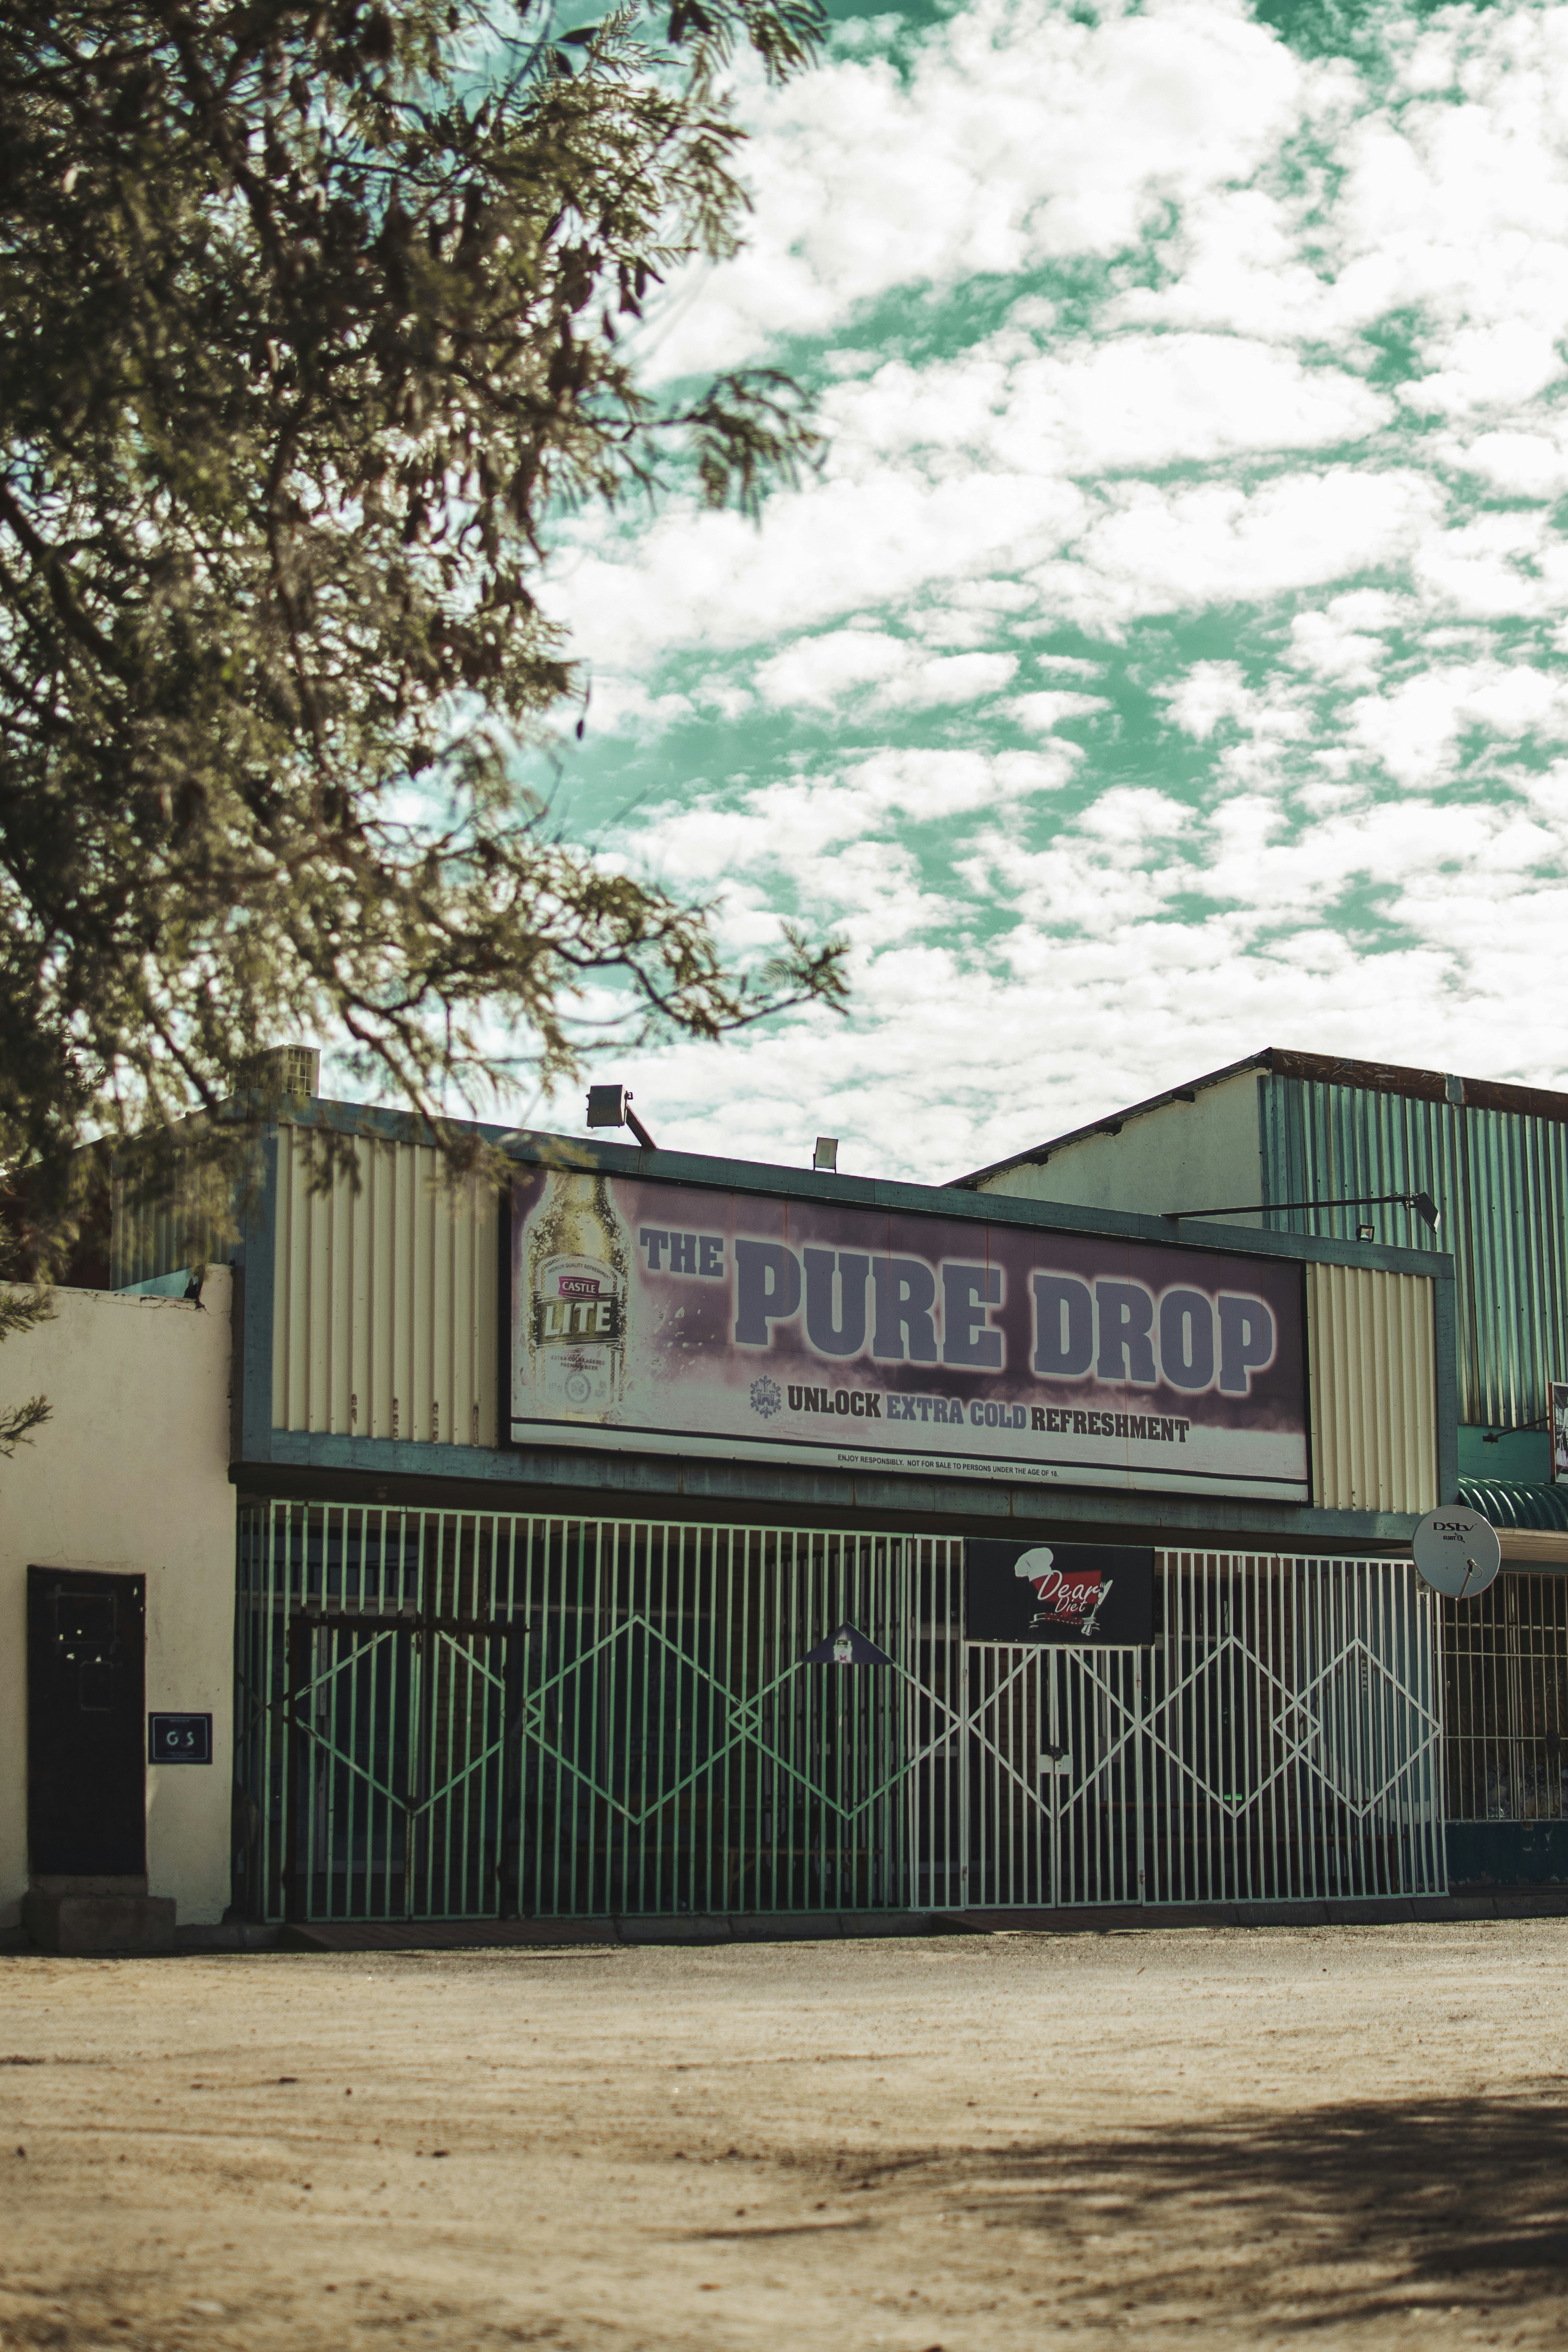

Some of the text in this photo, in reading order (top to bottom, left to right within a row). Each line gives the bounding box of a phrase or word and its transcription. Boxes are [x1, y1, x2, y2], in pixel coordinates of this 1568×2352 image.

[548, 1264, 564, 1273] PREMIUM
[584, 1264, 611, 1279] REFRESHMENT
[562, 1281, 596, 1294] CASTLE
[640, 1227, 1273, 1392] THE PURE DROP
[544, 1301, 612, 1336] LITE
[787, 1385, 1190, 1443] UNLOCK EXTRA COLD REFRESHMENT
[838, 1454, 859, 1462] ENJOY
[860, 1456, 904, 1466] RESPONSIBLY.
[1037, 1570, 1100, 1601] Dear
[1055, 1596, 1088, 1613] Diet
[166, 1730, 195, 1747] GS
